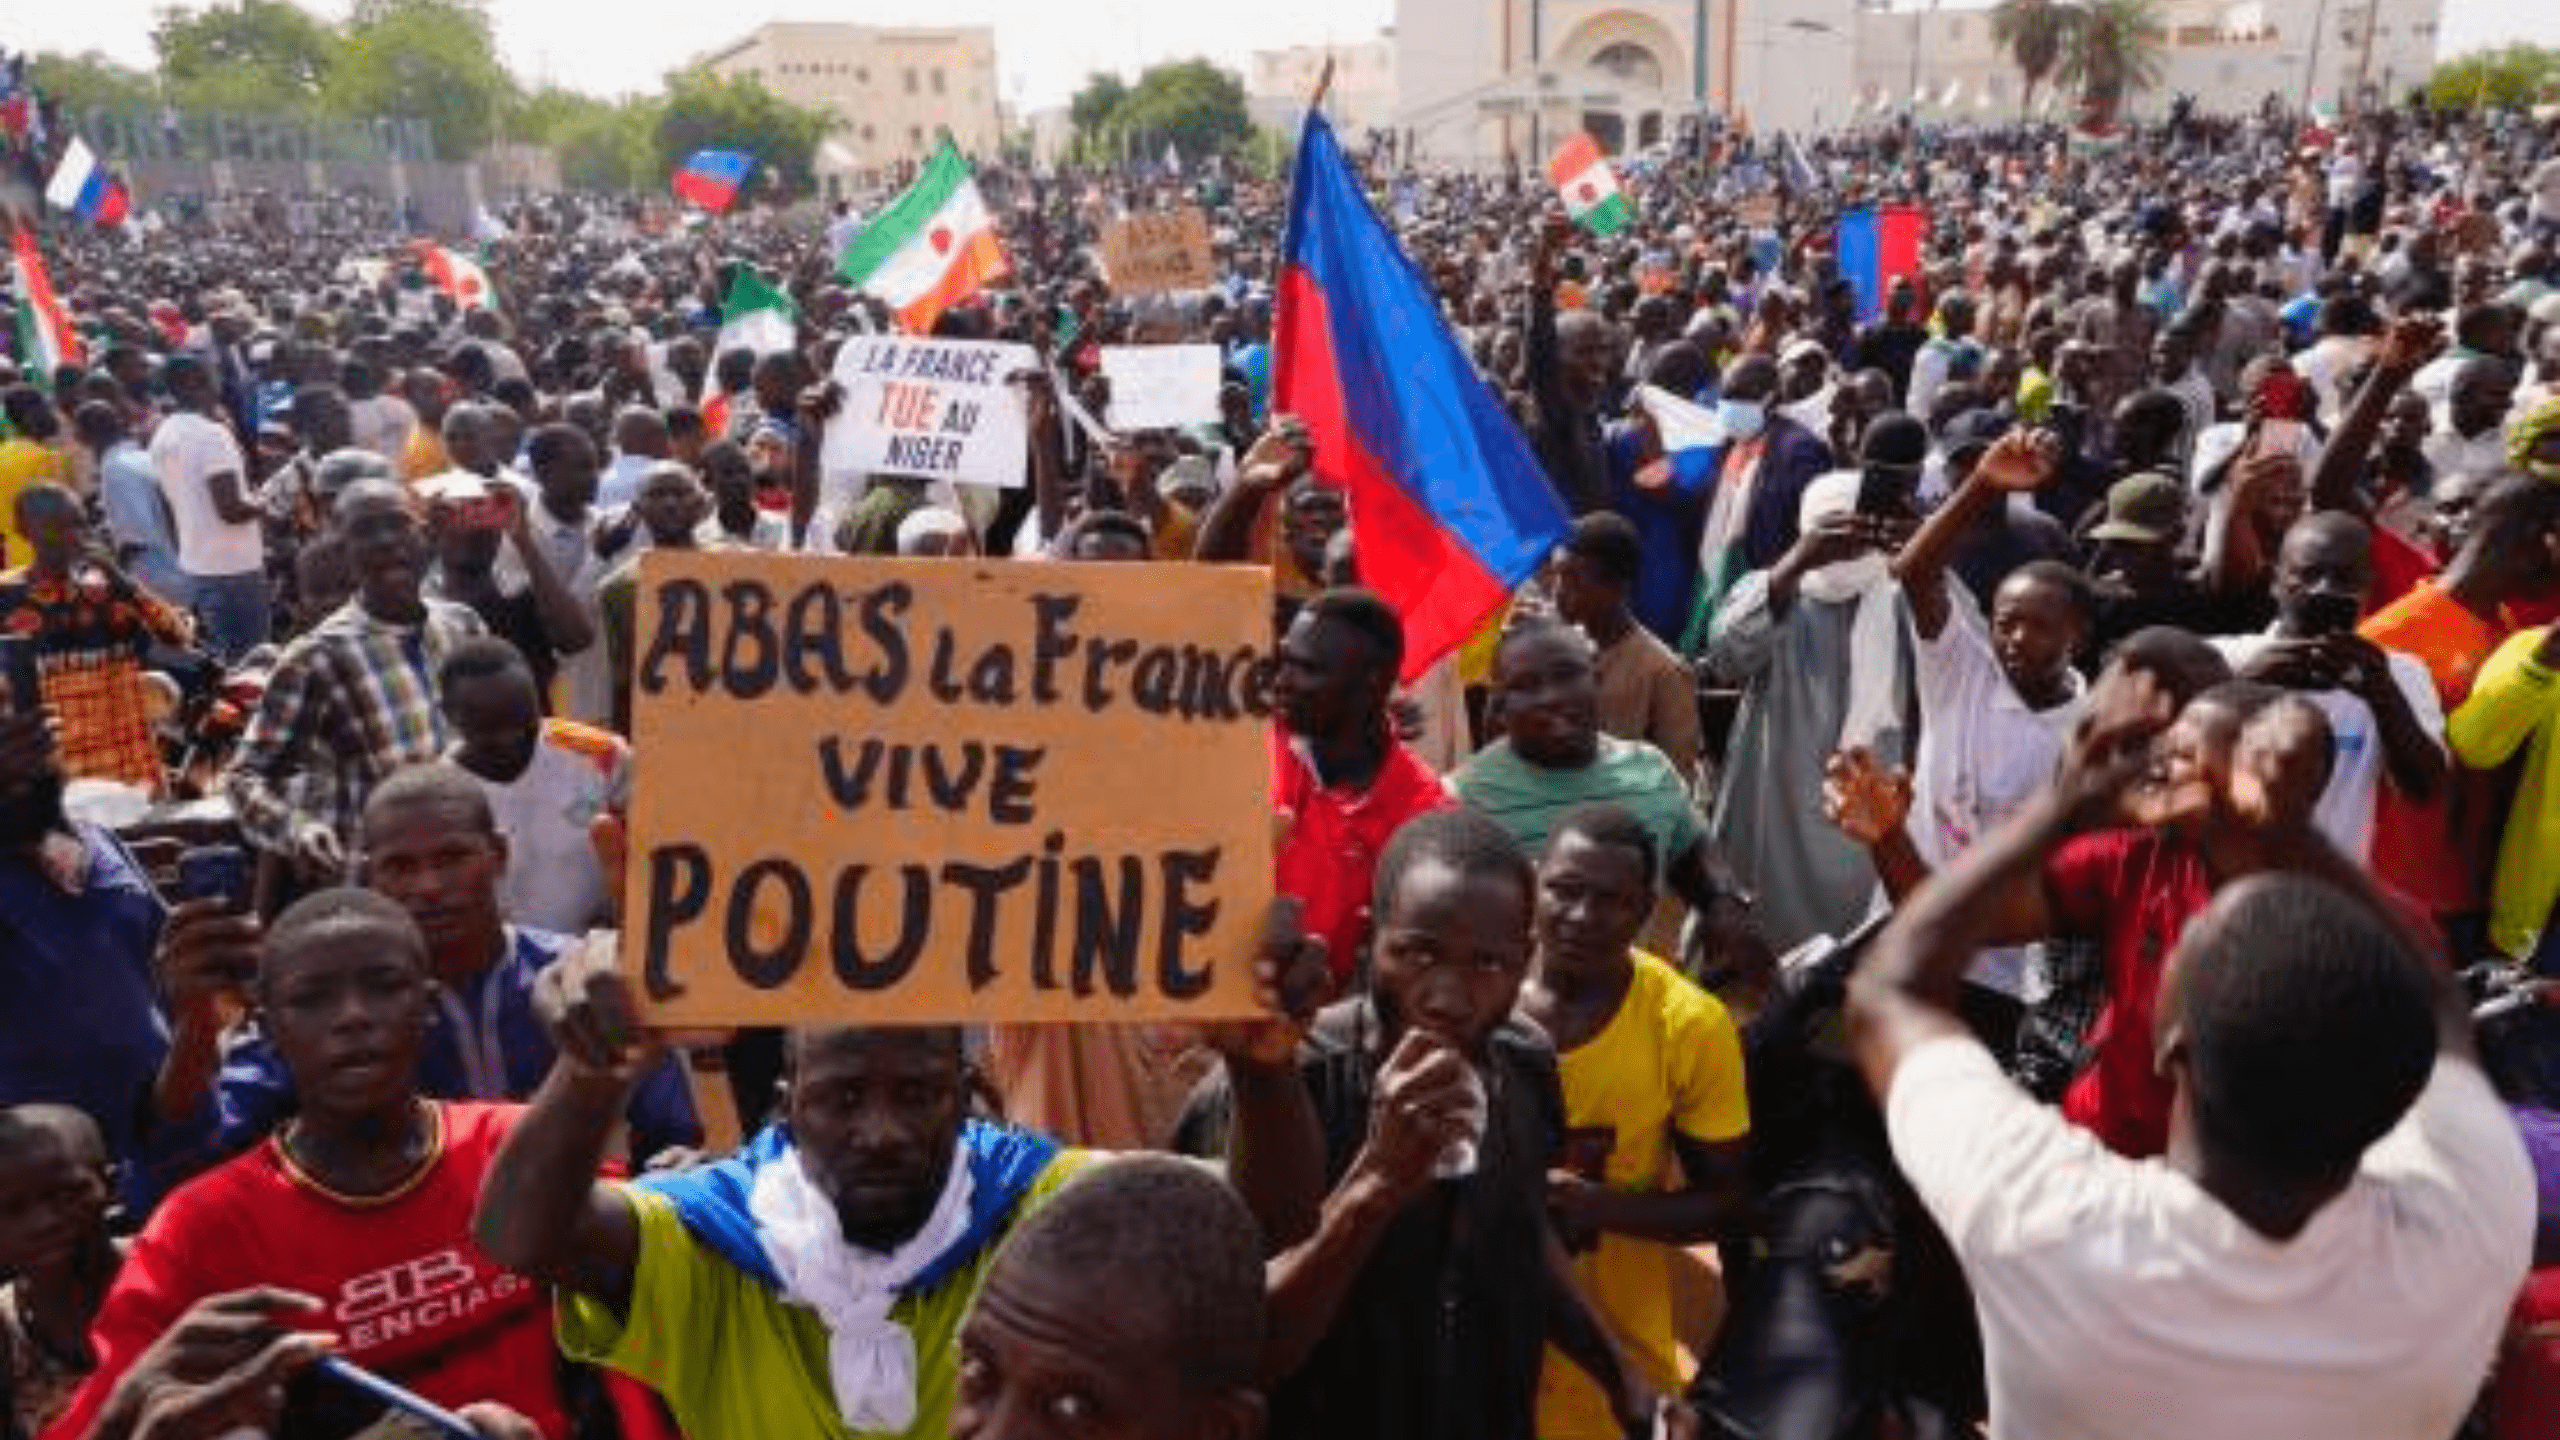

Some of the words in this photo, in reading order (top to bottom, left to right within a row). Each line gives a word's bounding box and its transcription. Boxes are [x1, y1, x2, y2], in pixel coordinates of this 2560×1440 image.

[863, 343, 899, 373] LA
[900, 345, 1000, 386] FRANCE
[876, 382, 939, 431] TUE
[940, 401, 982, 435] AU
[884, 435, 963, 471] NIGER
[640, 578, 913, 704] ABAS
[1031, 593, 1274, 723] France
[819, 735, 1046, 823] VIVE
